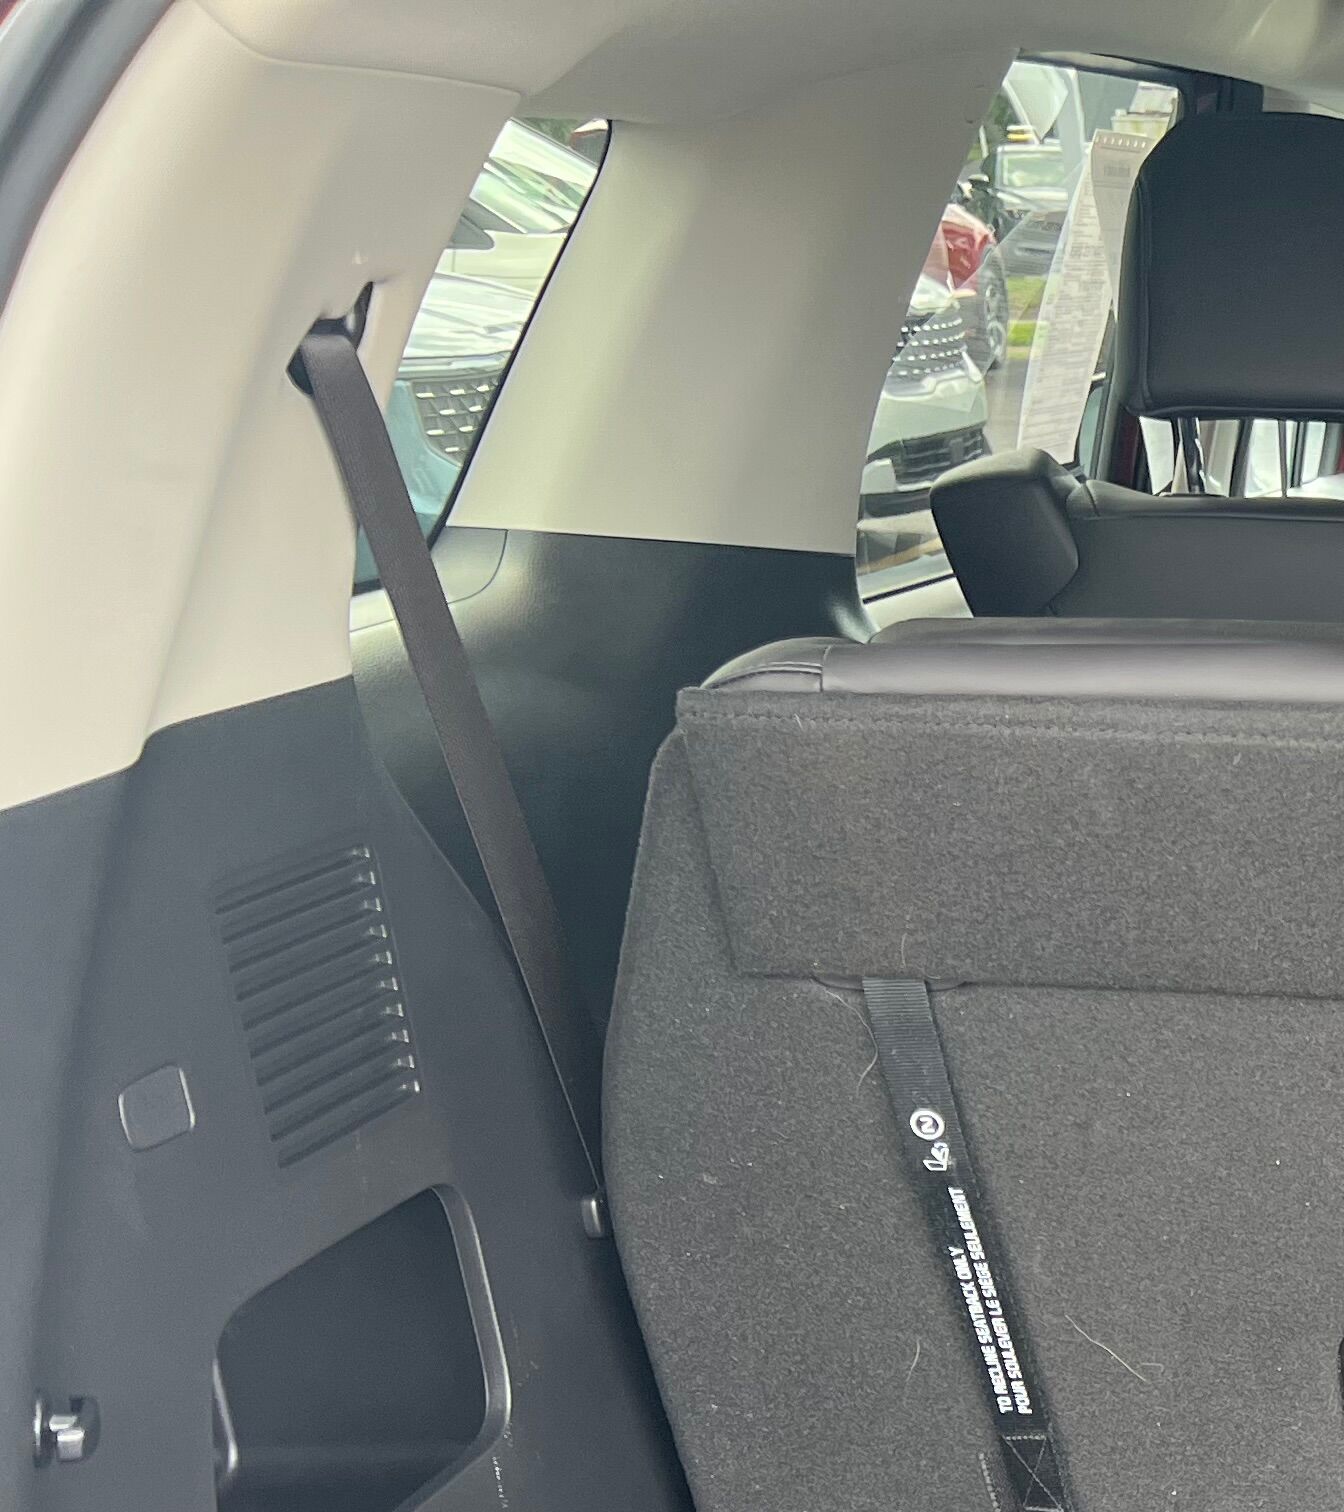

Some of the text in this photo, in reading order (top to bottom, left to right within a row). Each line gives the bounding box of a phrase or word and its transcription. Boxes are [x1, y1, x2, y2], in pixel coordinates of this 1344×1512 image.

[948, 1186, 986, 1260] SEULEMENT
[948, 1246, 1014, 1414] TO RECLINE SEATBACK ONLY
[985, 1299, 1002, 1316] LE
[992, 1318, 1023, 1379] SOULEVER
[1011, 1381, 1032, 1414] POUR
